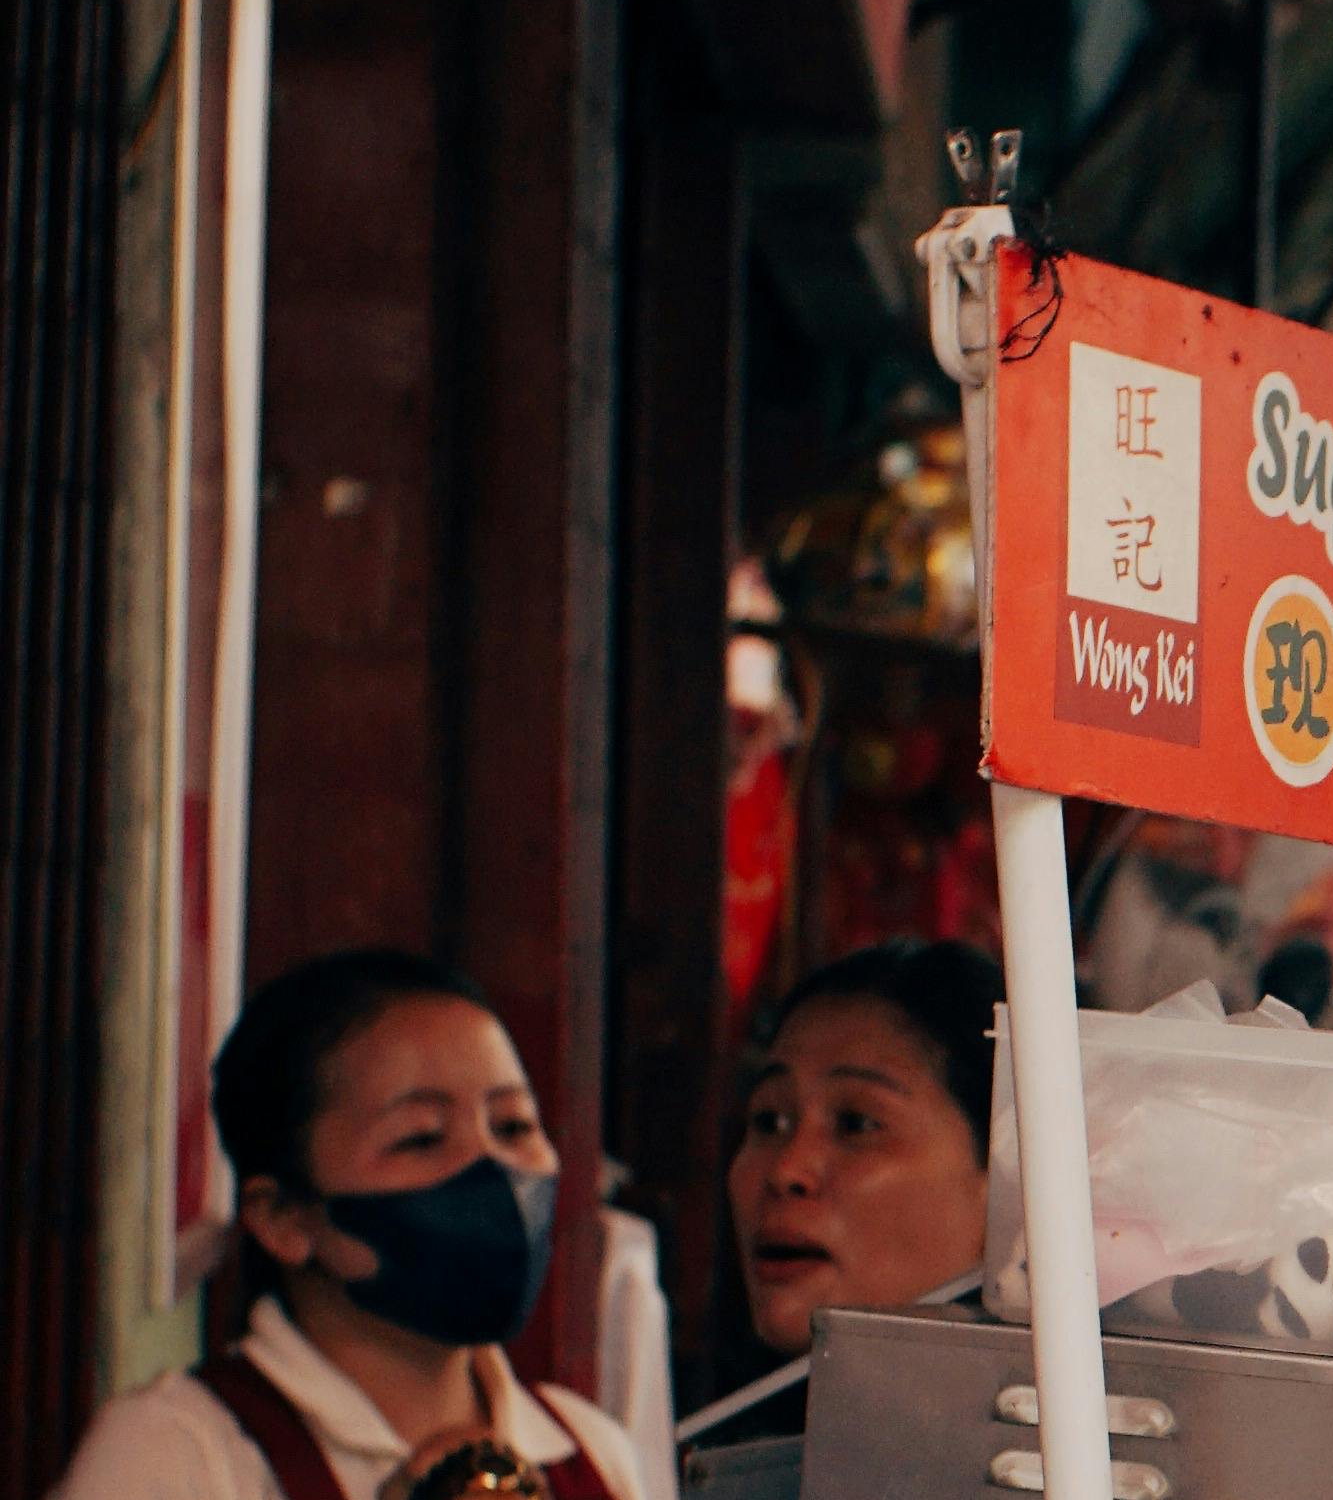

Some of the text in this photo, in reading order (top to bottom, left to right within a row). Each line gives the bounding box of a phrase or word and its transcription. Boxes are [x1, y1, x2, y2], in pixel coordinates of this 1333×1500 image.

[1106, 386, 1163, 591] 旺記
[1068, 609, 1196, 716] Wong Kei
